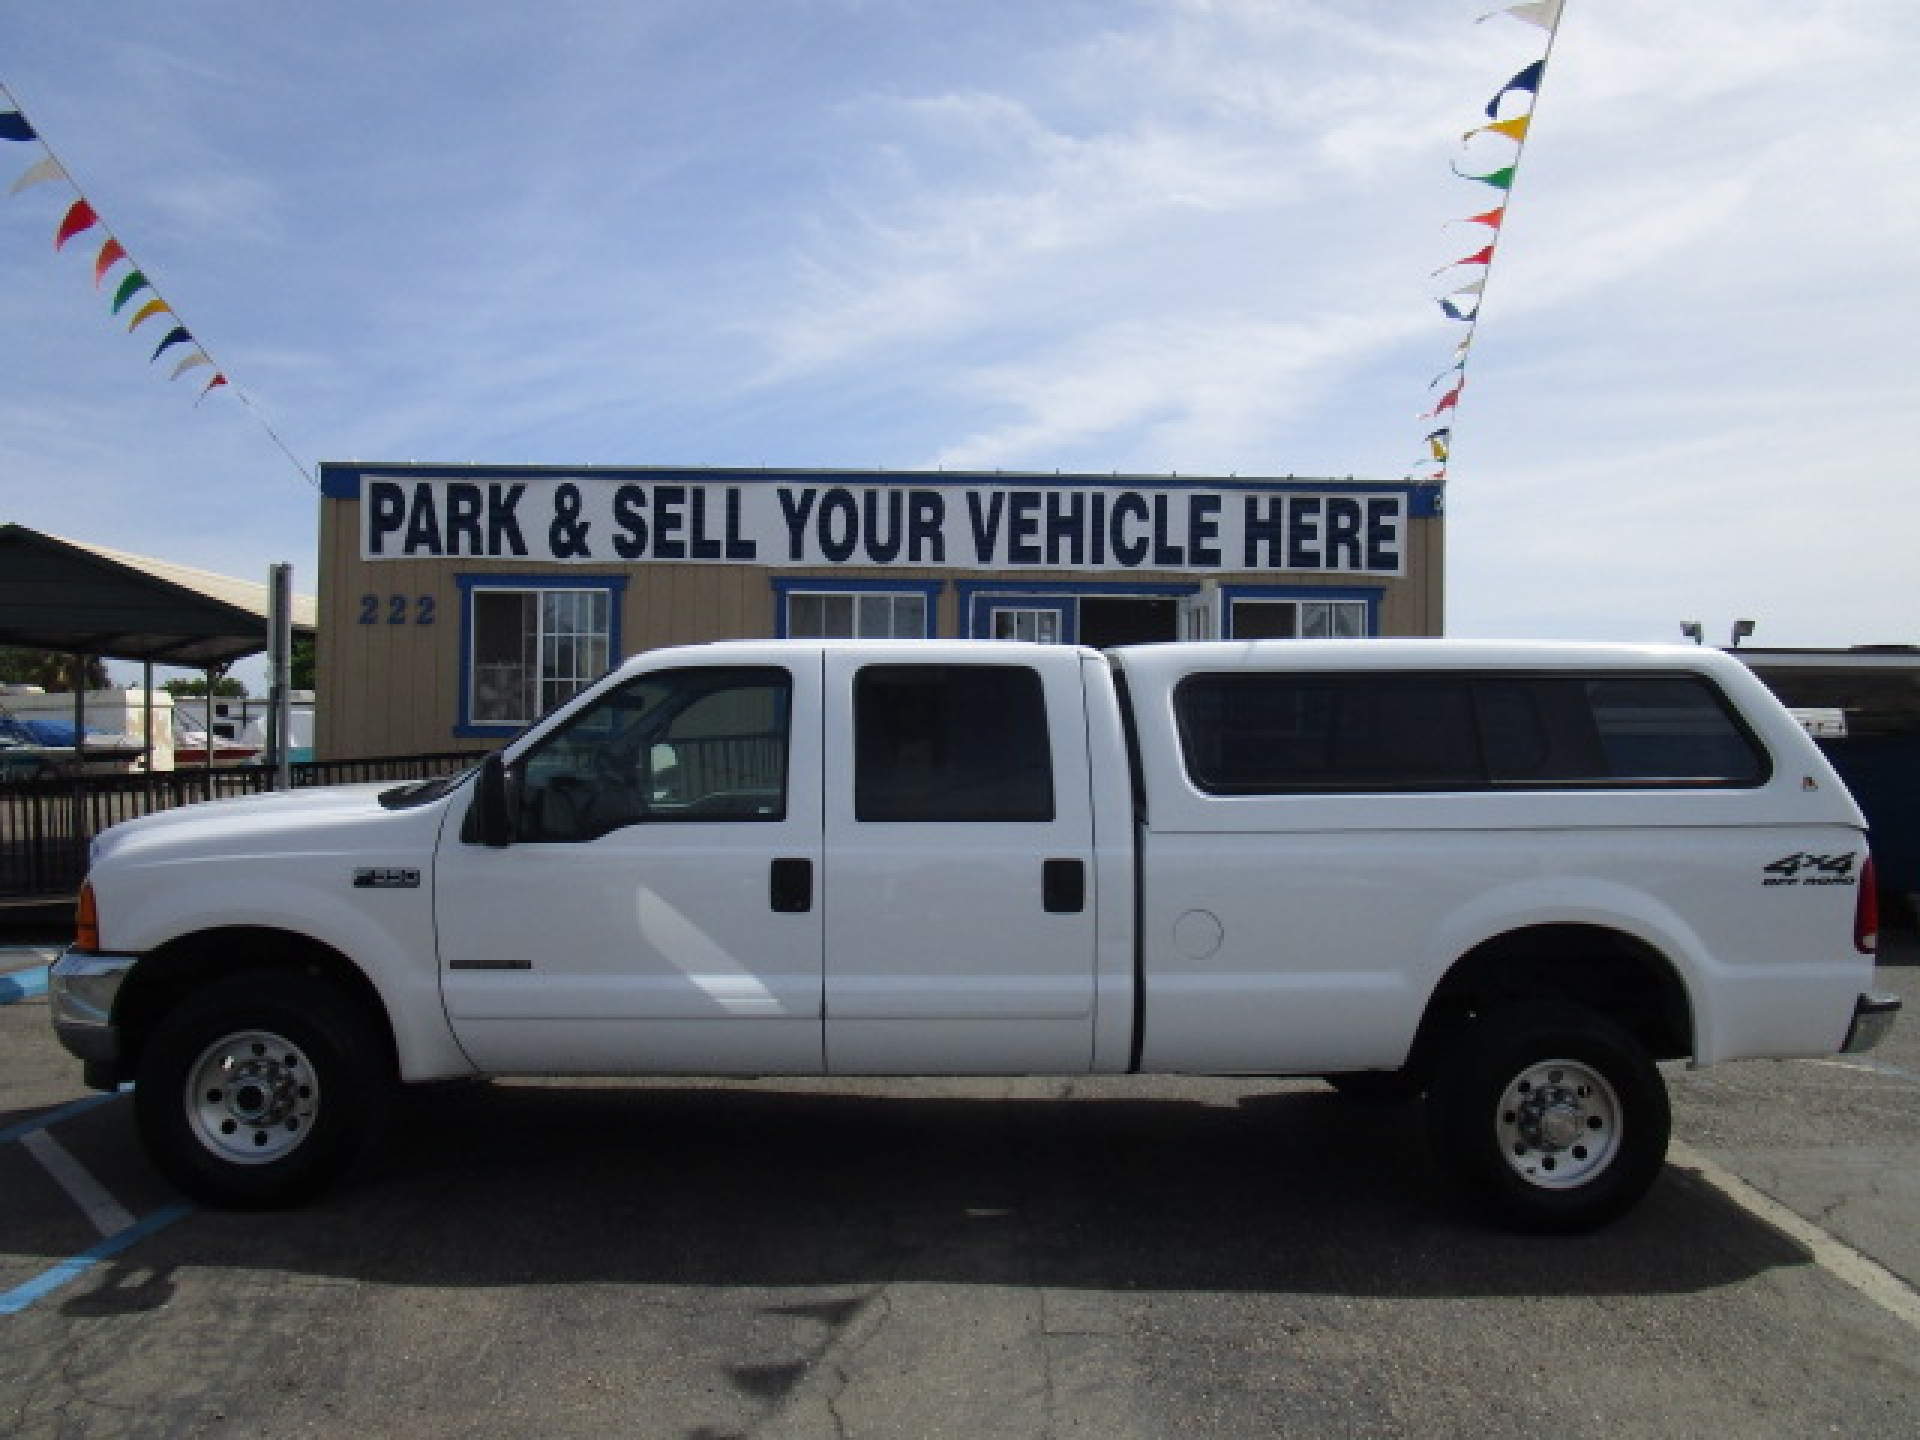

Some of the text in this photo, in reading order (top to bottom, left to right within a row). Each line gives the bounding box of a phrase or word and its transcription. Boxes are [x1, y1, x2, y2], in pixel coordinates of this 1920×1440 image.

[368, 481, 1400, 570] PARK & SELL YOUR VEHICLE HERE
[358, 594, 436, 625] 222
